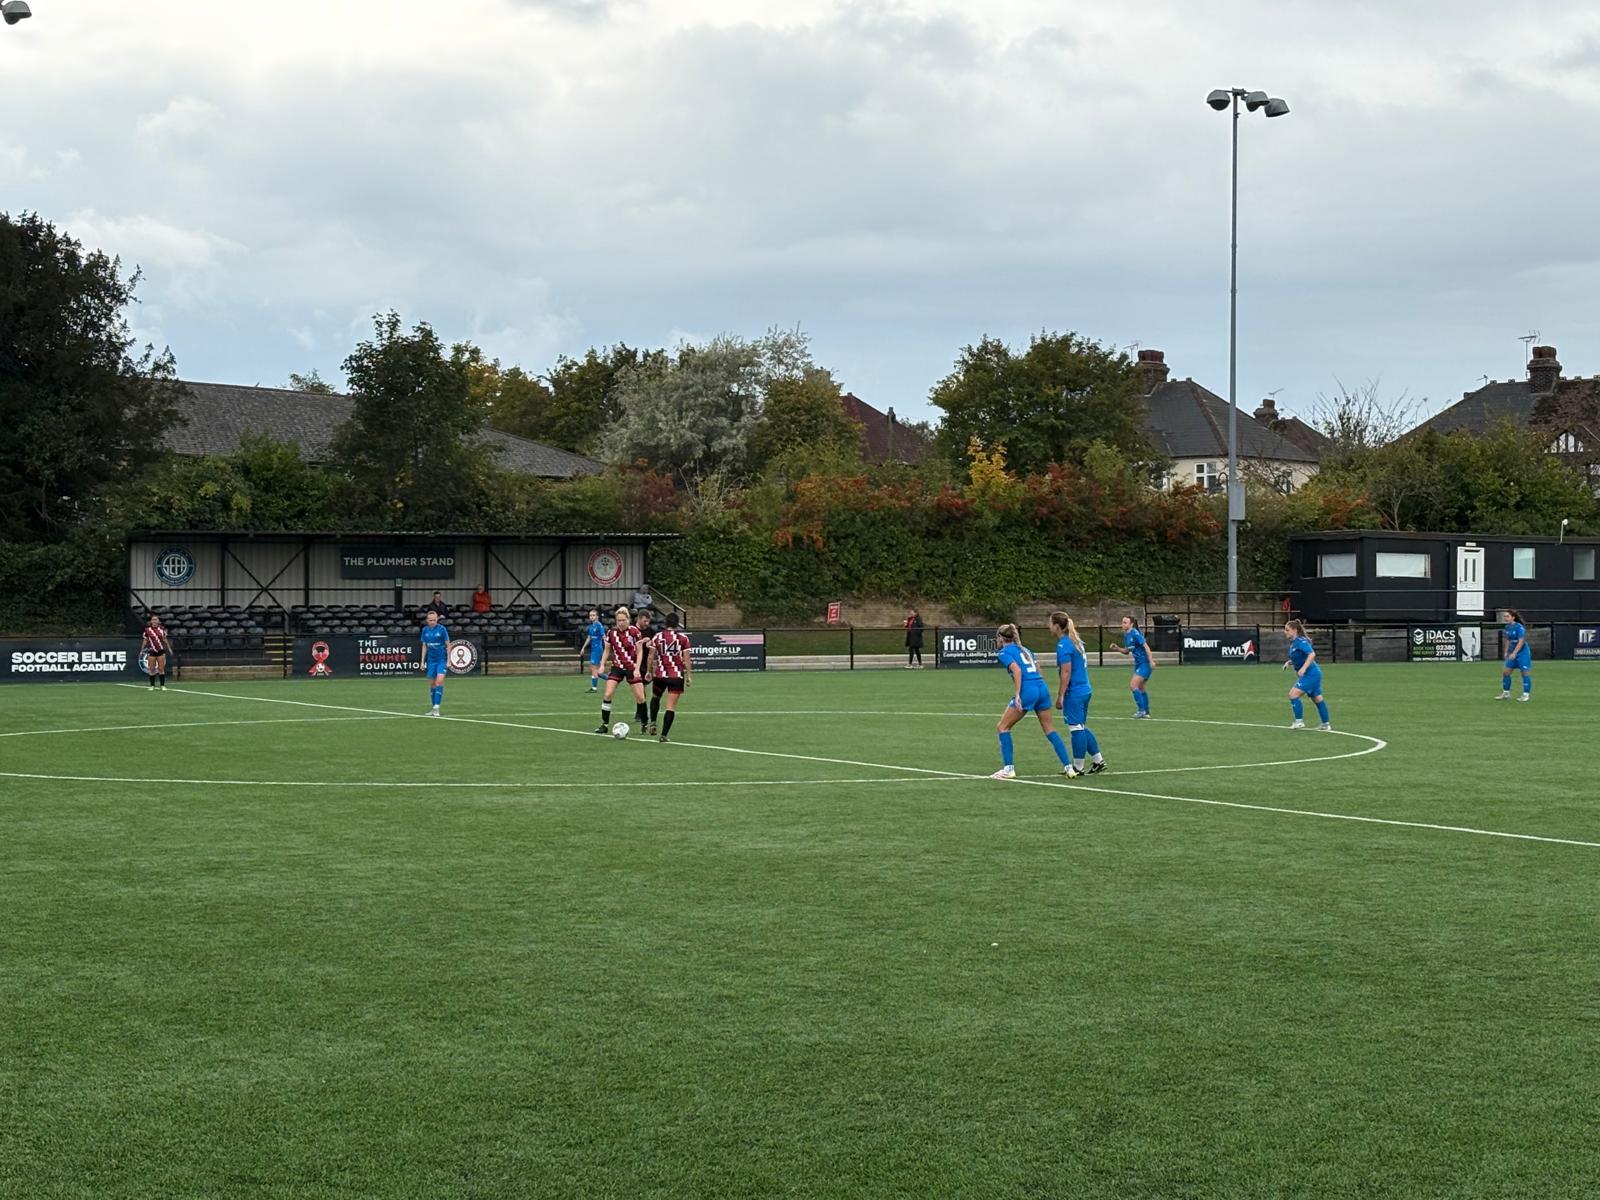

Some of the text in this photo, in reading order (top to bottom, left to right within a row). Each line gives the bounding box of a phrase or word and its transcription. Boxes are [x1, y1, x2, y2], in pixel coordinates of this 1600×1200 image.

[343, 557, 454, 566] THE PLUMMER STAND
[358, 639, 378, 647] THE
[659, 638, 680, 656] 14
[943, 635, 998, 651] finelin
[359, 647, 412, 655] LAURENCE
[728, 646, 741, 654] LLP
[1221, 646, 1245, 656] RWL
[11, 651, 79, 664] SOCCER
[81, 651, 126, 663] ELITE
[360, 654, 407, 662] PLUMMER
[11, 662, 126, 673] FOOTBALL ACADEMY
[360, 662, 427, 670] FOUNDATIO
